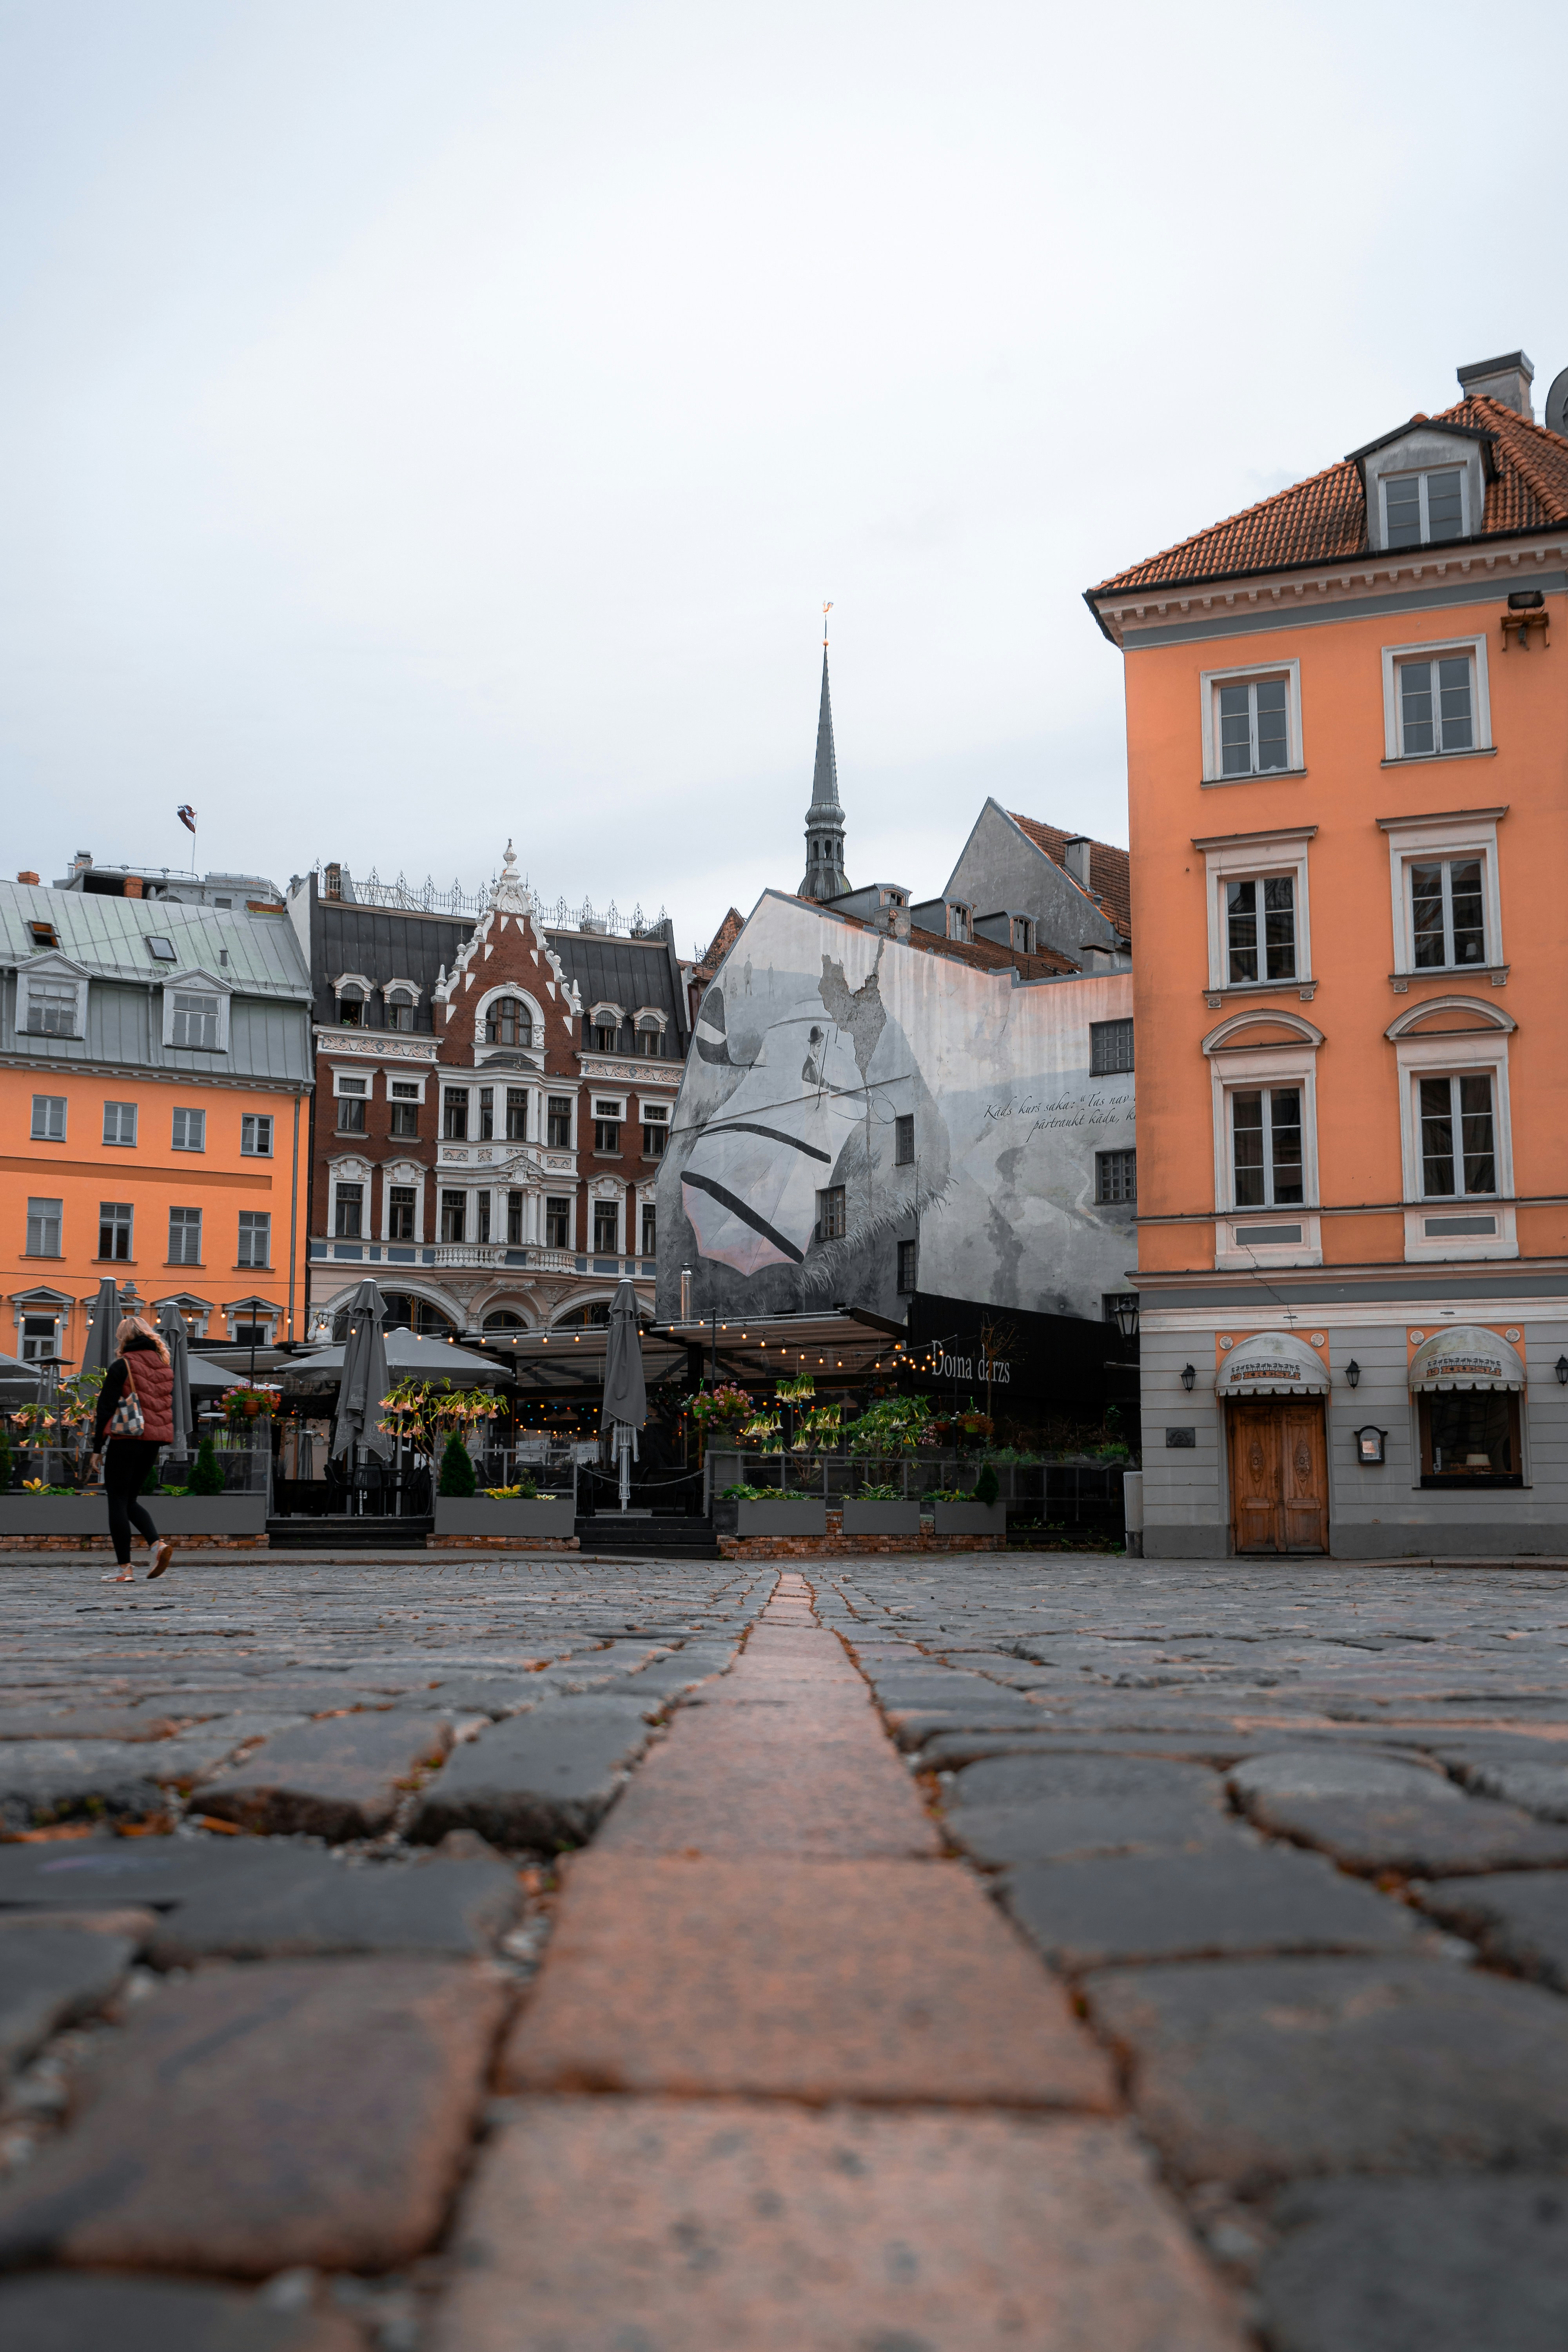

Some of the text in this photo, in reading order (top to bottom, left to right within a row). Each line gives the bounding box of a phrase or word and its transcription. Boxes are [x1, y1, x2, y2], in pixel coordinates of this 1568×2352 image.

[983, 1096, 1017, 1121] Kāds
[1018, 1095, 1040, 1114] kurš
[1043, 1092, 1075, 1112] saka:
[1109, 1094, 1130, 1105] nav
[1024, 1108, 1085, 1143] pārtraukt
[1088, 1107, 1120, 1125] kādu,
[931, 1339, 973, 1380] Doma
[1426, 1365, 1502, 1377] 13 KRESLI
[1230, 1370, 1301, 1383] 13 KRESLI
